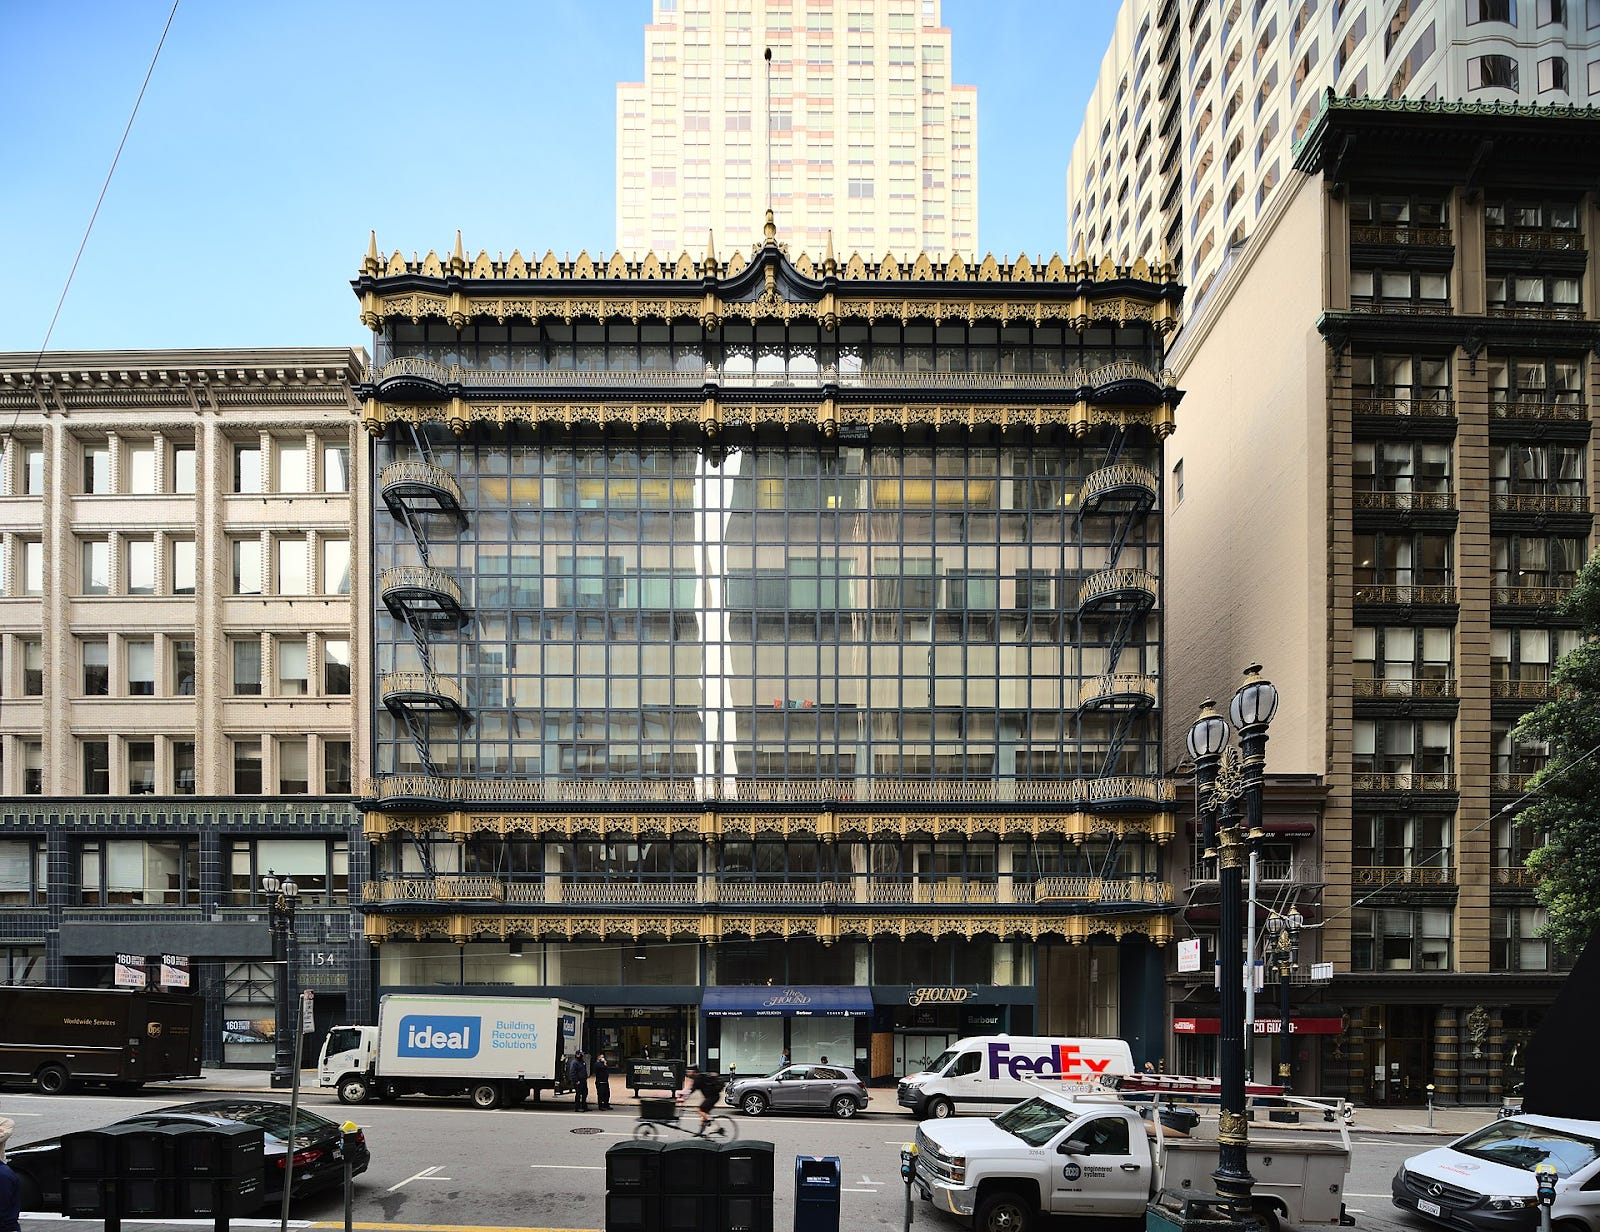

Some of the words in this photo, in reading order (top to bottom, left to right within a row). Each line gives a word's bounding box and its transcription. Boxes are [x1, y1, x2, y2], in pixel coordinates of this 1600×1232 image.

[116, 954, 131, 965] 160
[162, 954, 176, 965] 160
[311, 952, 335, 966] 154
[782, 989, 803, 997] The
[908, 987, 968, 1007] HOUND
[763, 995, 812, 1007] HOUND
[93, 1018, 116, 1026] Services
[225, 1020, 239, 1030] 160
[564, 1018, 575, 1032] ideal
[967, 1015, 999, 1024] Barbour
[496, 1021, 535, 1032] Building
[407, 1025, 470, 1050] ideal
[492, 1030, 538, 1041] Recovery
[492, 1039, 538, 1050] Solutions
[988, 1042, 1112, 1081] FedEx
[1061, 1082, 1091, 1093] Expres
